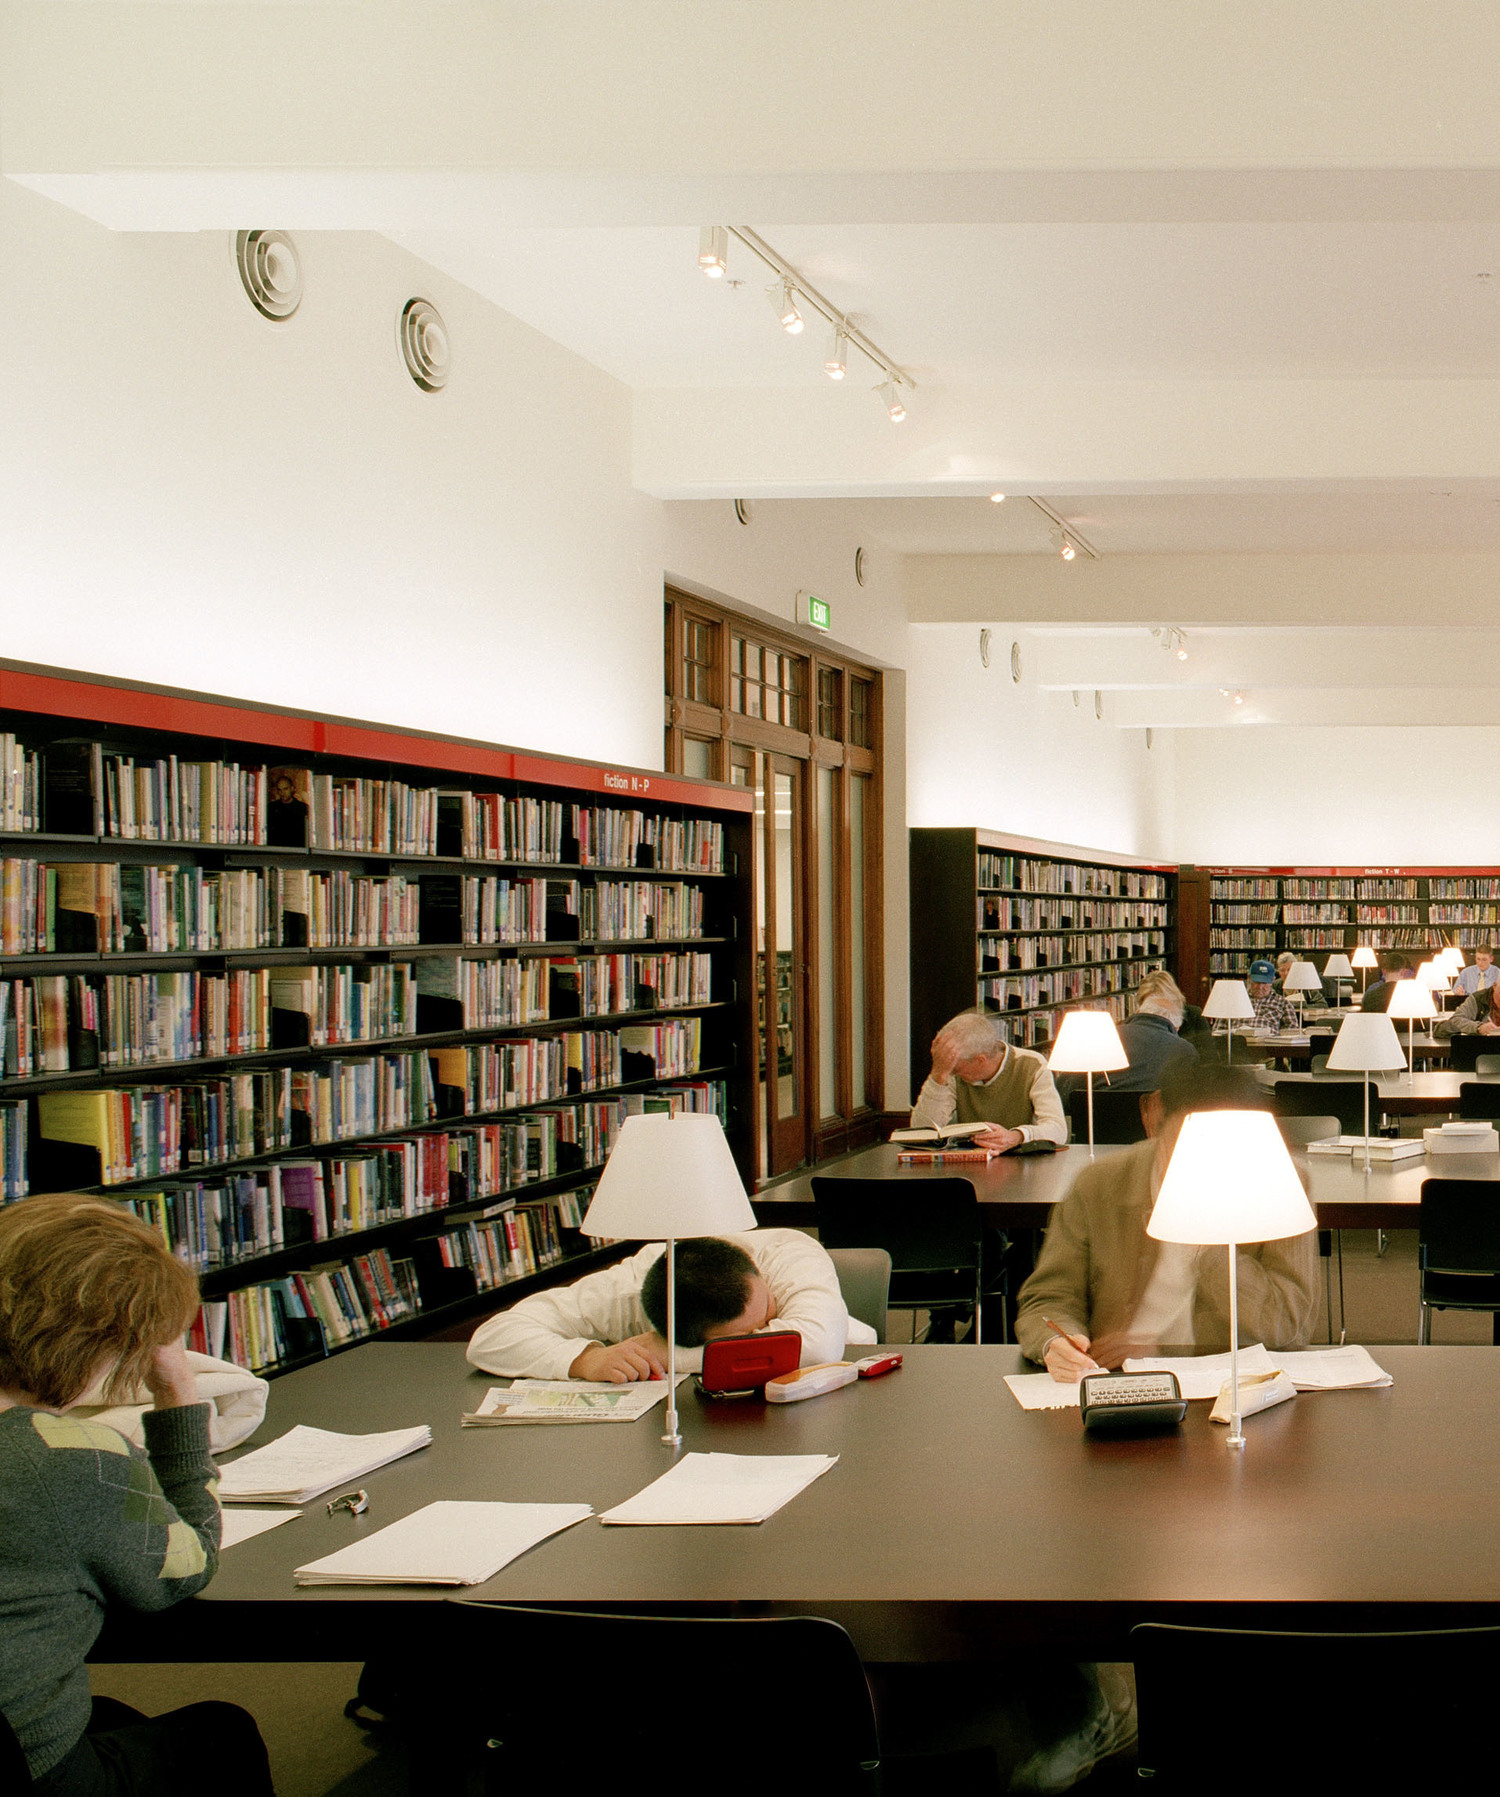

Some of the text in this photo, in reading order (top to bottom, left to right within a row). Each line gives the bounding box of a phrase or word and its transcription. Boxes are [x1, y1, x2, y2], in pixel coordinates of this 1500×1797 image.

[604, 773, 629, 790] fiction
[631, 776, 638, 791] N
[643, 778, 650, 792] P
